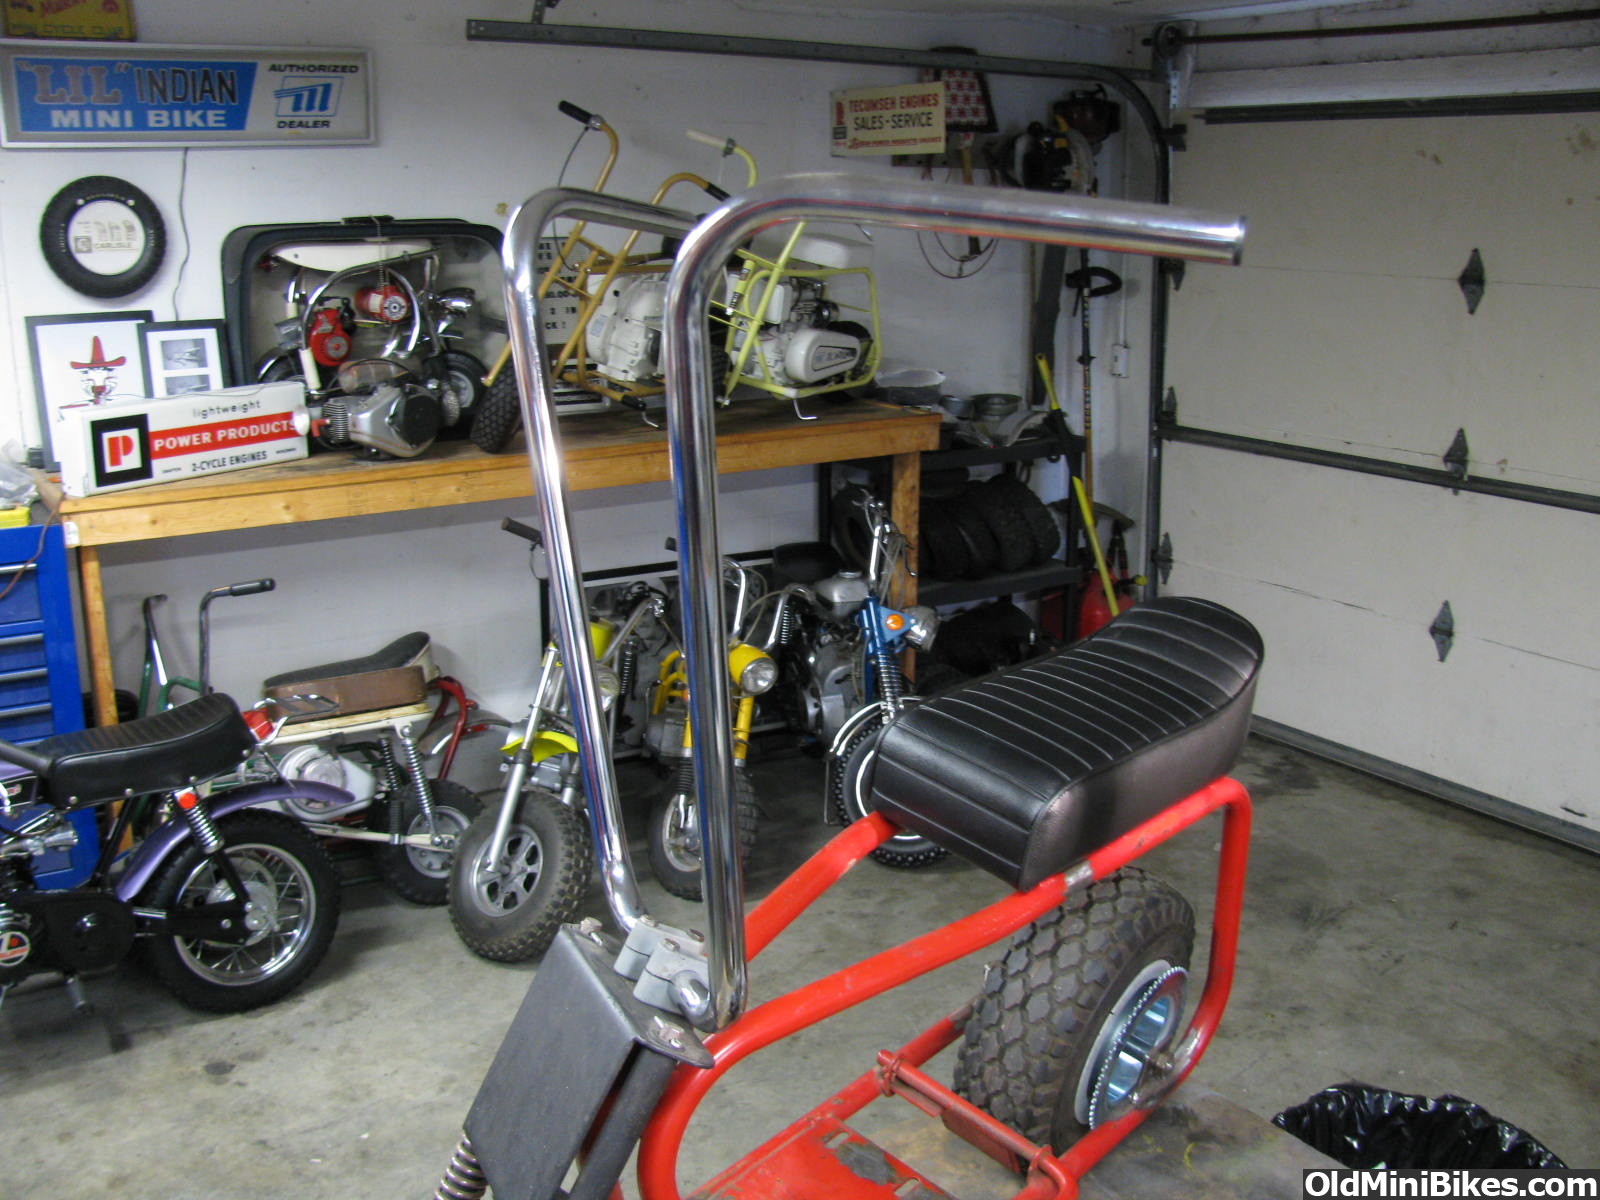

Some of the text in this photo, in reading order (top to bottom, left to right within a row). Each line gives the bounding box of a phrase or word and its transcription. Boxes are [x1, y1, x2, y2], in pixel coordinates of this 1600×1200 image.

[269, 64, 359, 74] AUTHORIZED
[134, 67, 239, 105] INDIAN
[899, 93, 939, 109] ENGINES
[51, 109, 227, 128] MINI BIKE
[277, 120, 331, 129] DEALER
[192, 400, 261, 419] lightweight
[153, 432, 212, 452] POWER
[191, 457, 227, 472] 2-CYCLE
[229, 450, 268, 466] ENGINES
